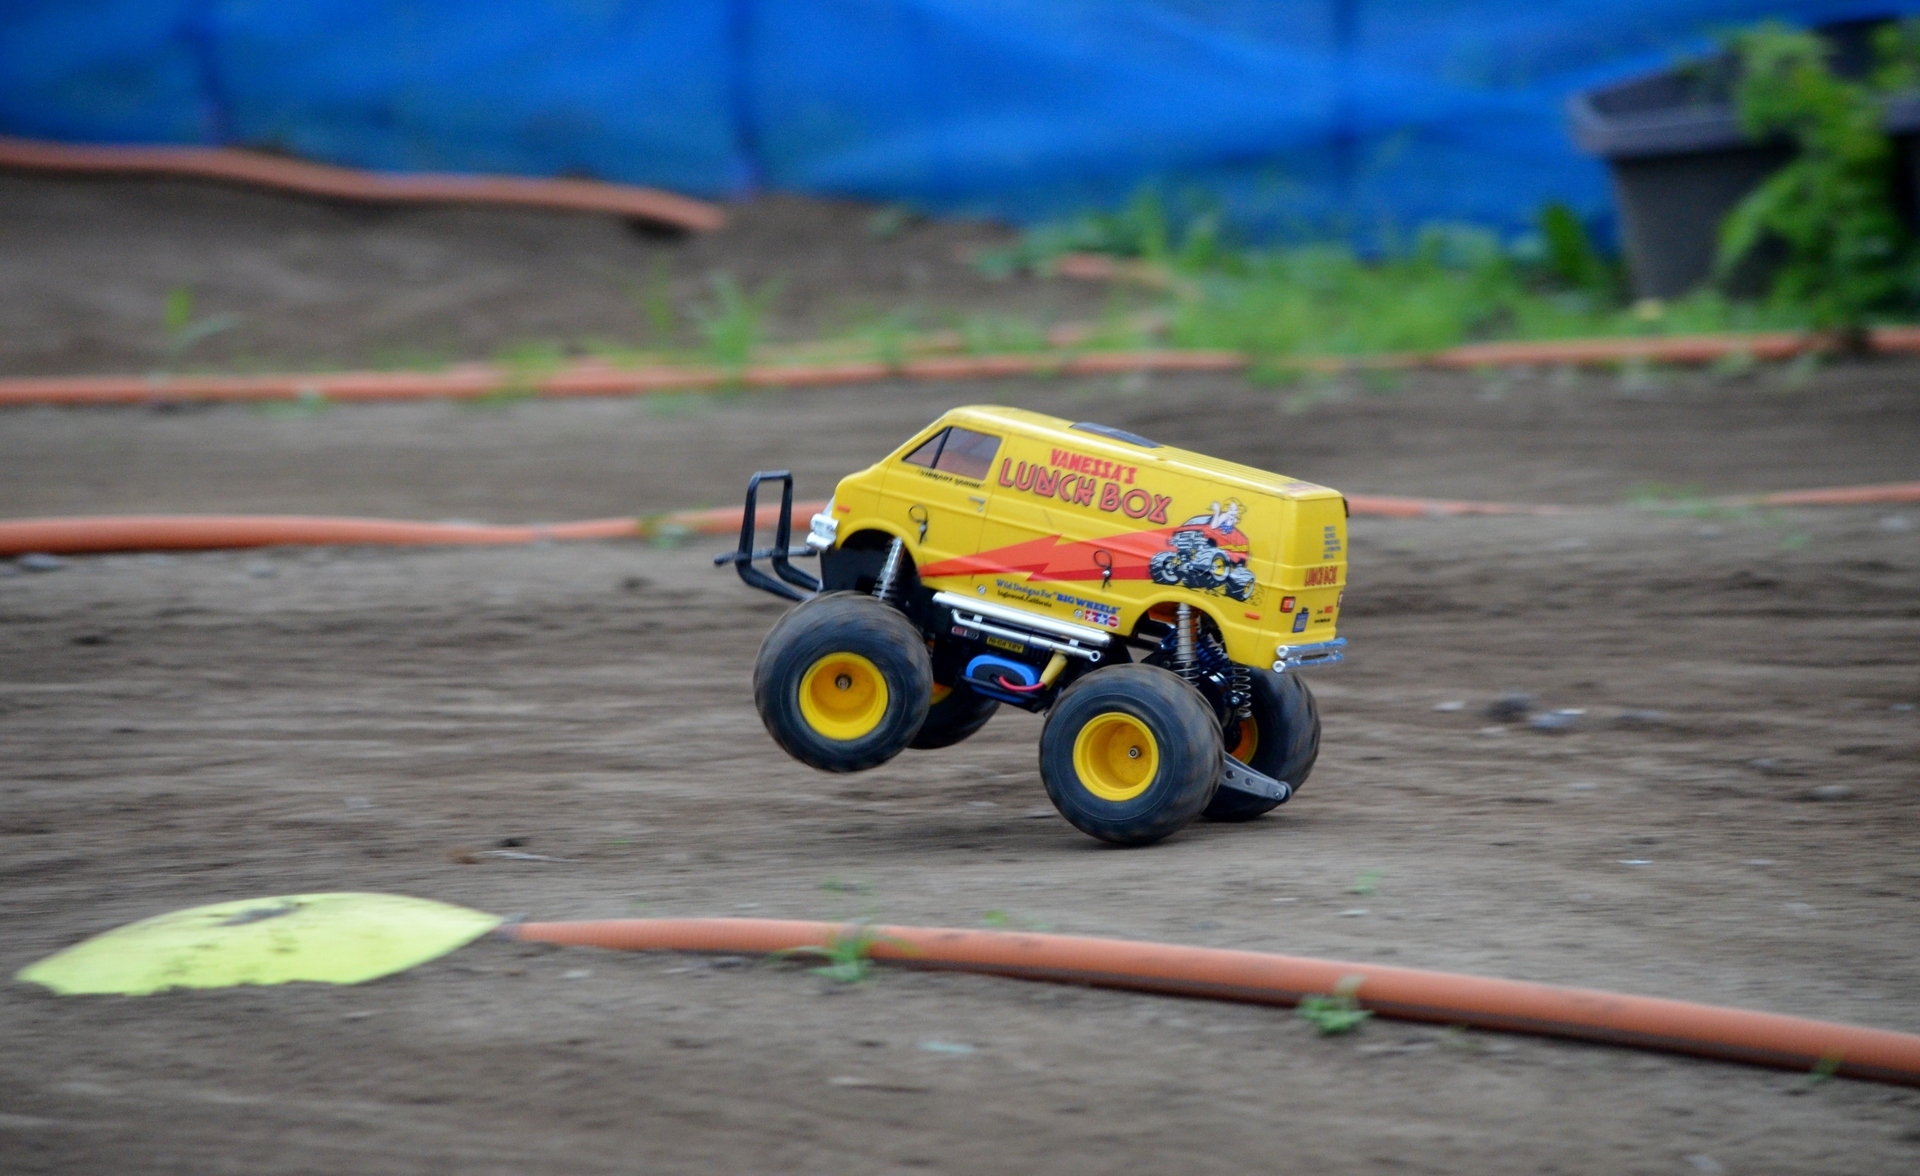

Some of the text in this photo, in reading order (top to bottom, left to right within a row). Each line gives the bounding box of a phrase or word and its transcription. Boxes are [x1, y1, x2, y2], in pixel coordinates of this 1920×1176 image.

[1050, 448, 1137, 484] VANESSA'S
[998, 457, 1172, 525] LUNCH BOX
[996, 579, 1012, 590] Wild
[1013, 582, 1040, 596] Designs
